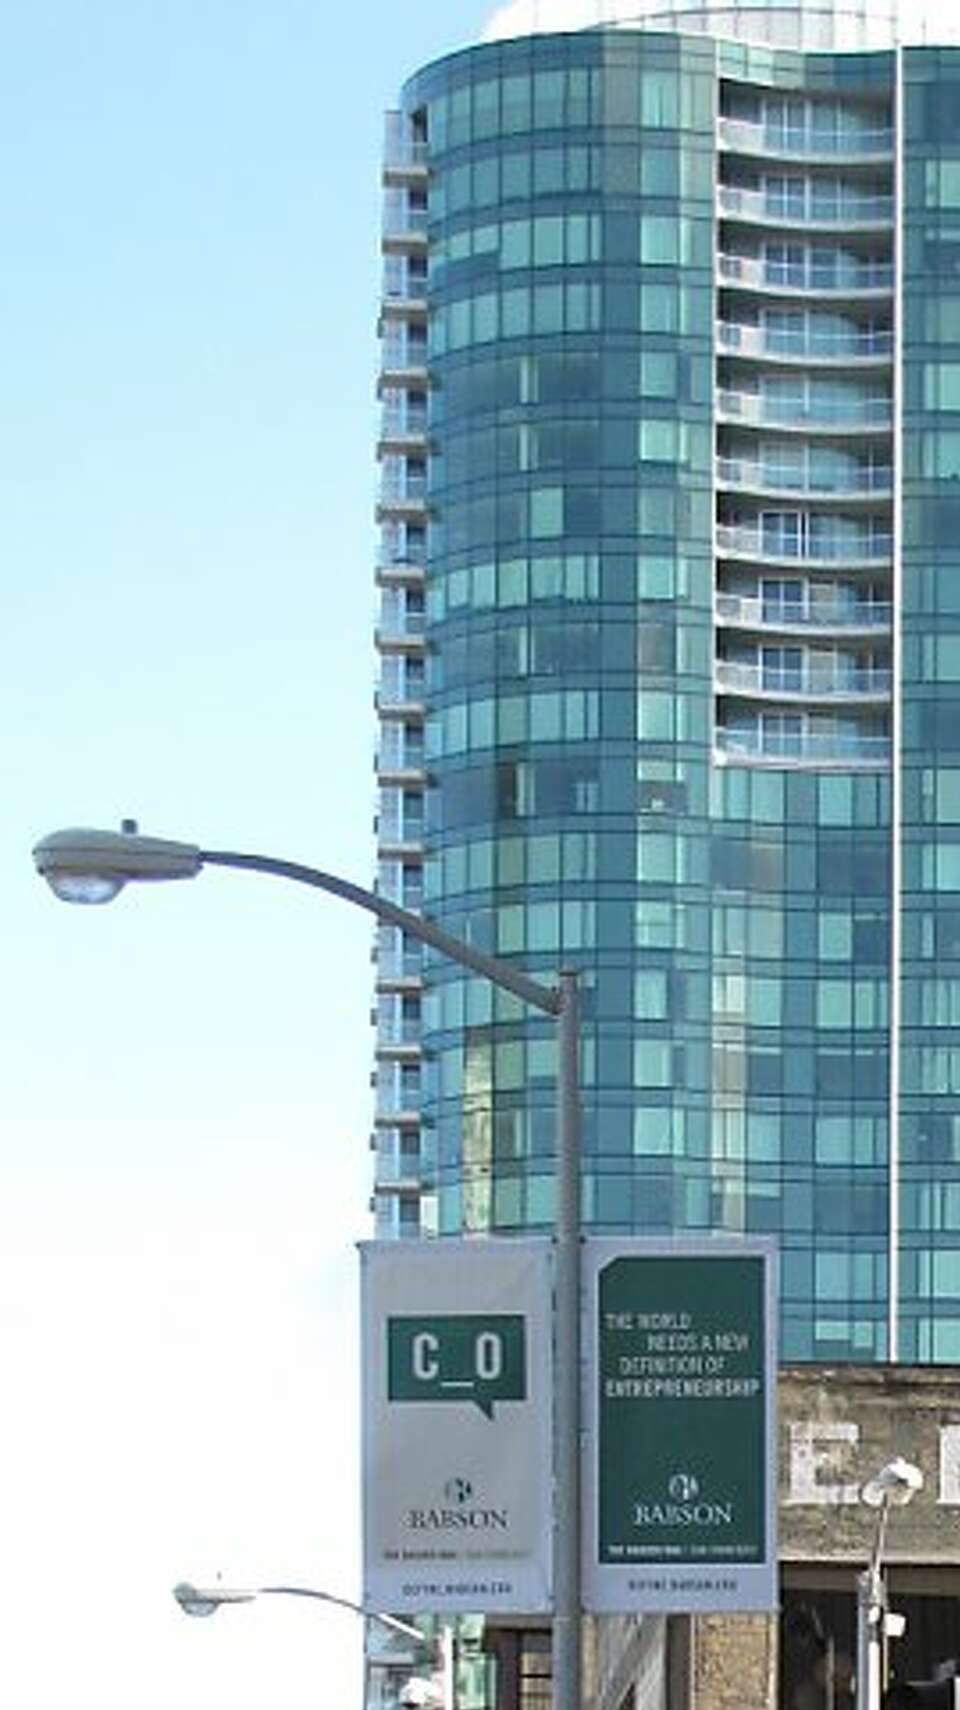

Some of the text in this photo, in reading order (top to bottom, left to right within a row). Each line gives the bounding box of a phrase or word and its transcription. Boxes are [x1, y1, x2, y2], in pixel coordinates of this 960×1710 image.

[605, 1314, 692, 1329] THE WORLD
[648, 1333, 749, 1350] NEEDS A NEW
[619, 1356, 725, 1374] DEFINITION OF
[605, 1378, 760, 1397] ENTREPRENEURSHIP
[408, 1509, 508, 1529] BABSON
[634, 1502, 733, 1525] BABSON
